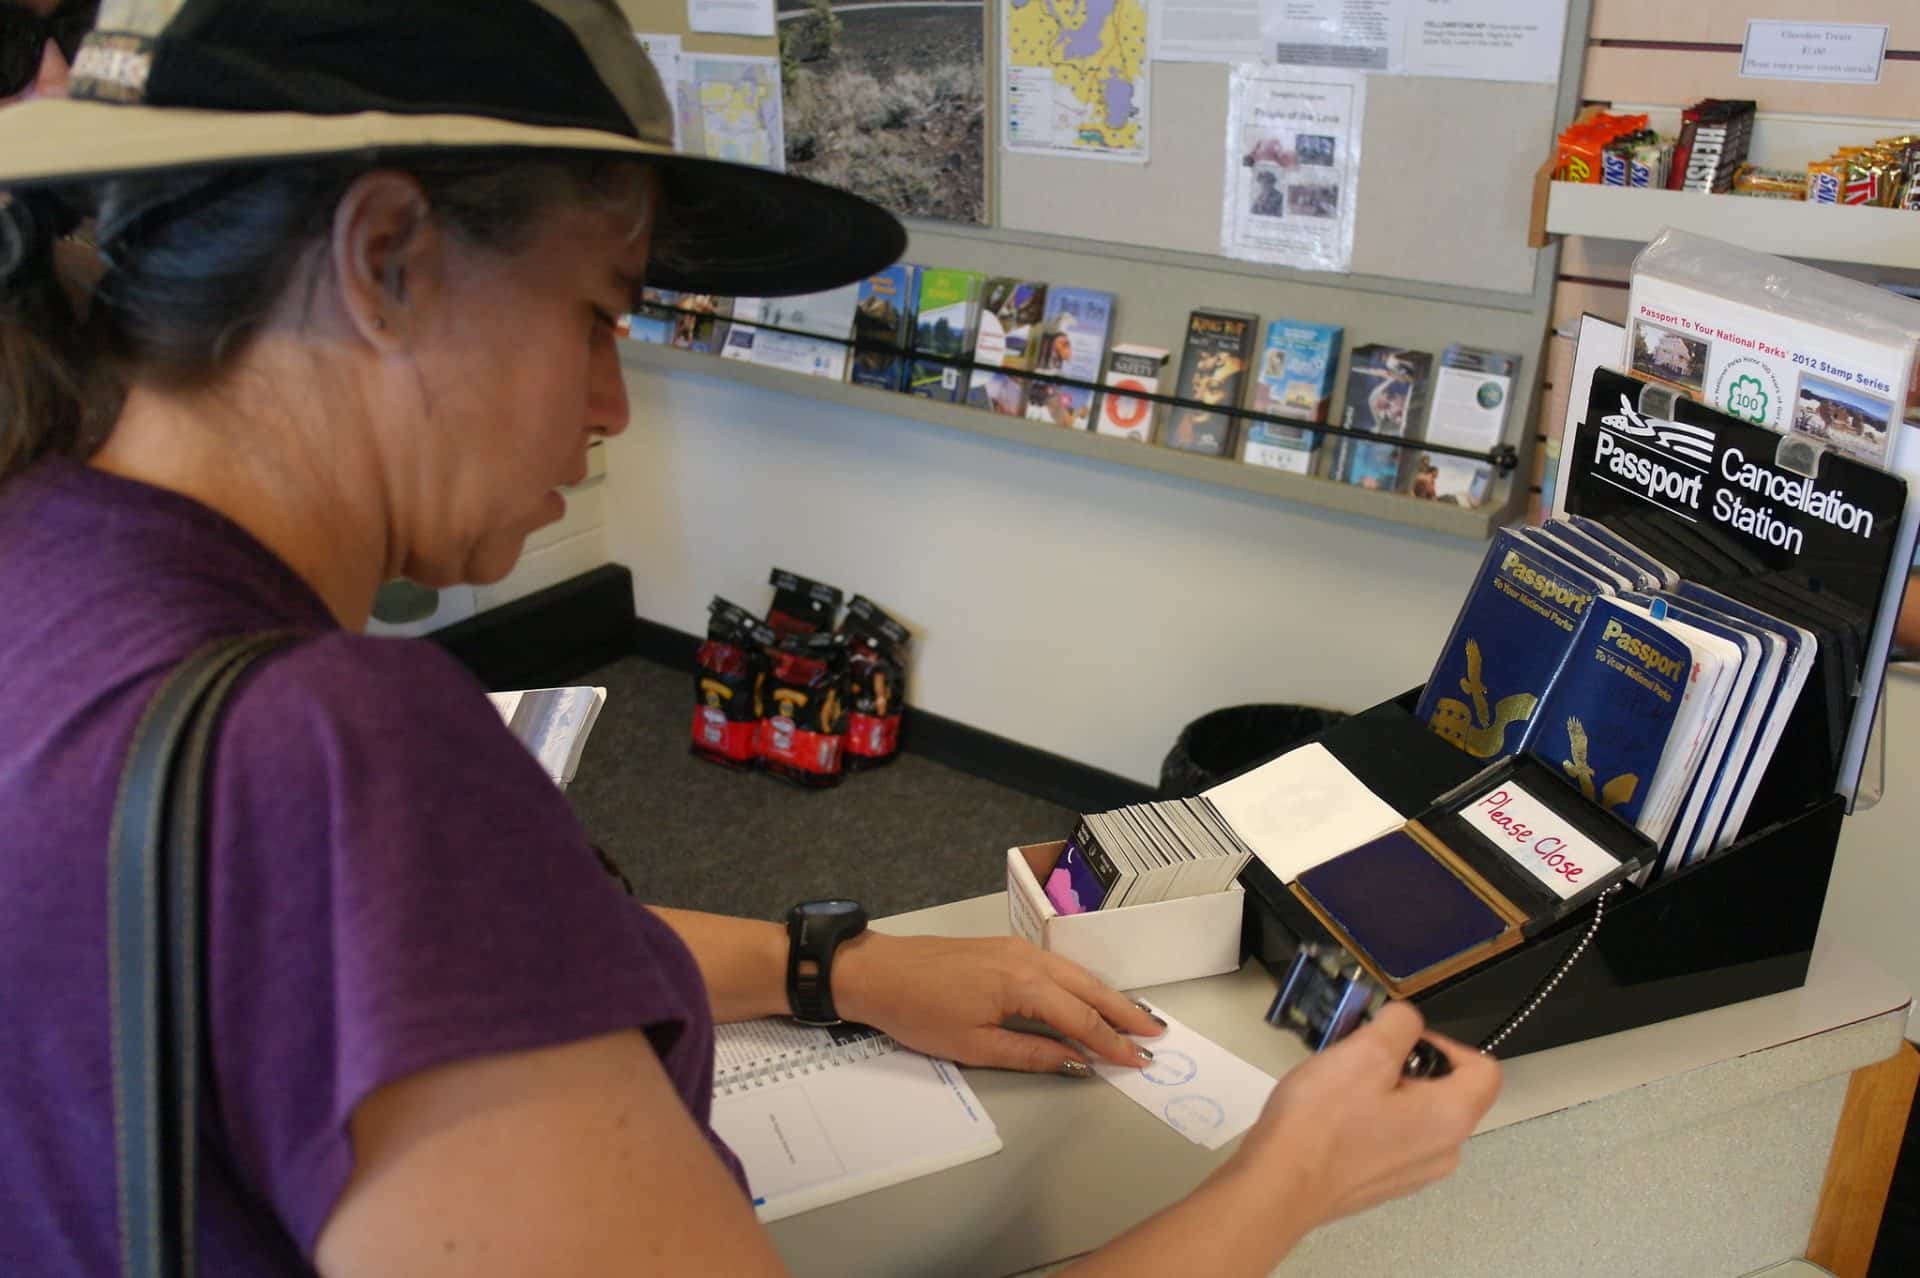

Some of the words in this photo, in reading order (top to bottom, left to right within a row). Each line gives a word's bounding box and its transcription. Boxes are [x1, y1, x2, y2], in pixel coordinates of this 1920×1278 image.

[1640, 305, 1678, 326] Passport
[1681, 318, 1691, 329] To
[1694, 321, 1714, 336] Your
[1716, 329, 1756, 349] National
[1792, 352, 1817, 369] 2012
[1820, 361, 1853, 381] Stamp
[1856, 373, 1890, 393] Series
[1736, 393, 1759, 411] 100
[1594, 431, 1703, 509] Passport
[1721, 447, 1874, 539] Cancellation
[1712, 488, 1804, 555] Station
[1501, 550, 1588, 615] Passport
[1602, 619, 1685, 683] Passport
[1478, 791, 1534, 843] Please
[1533, 837, 1584, 883] Close
